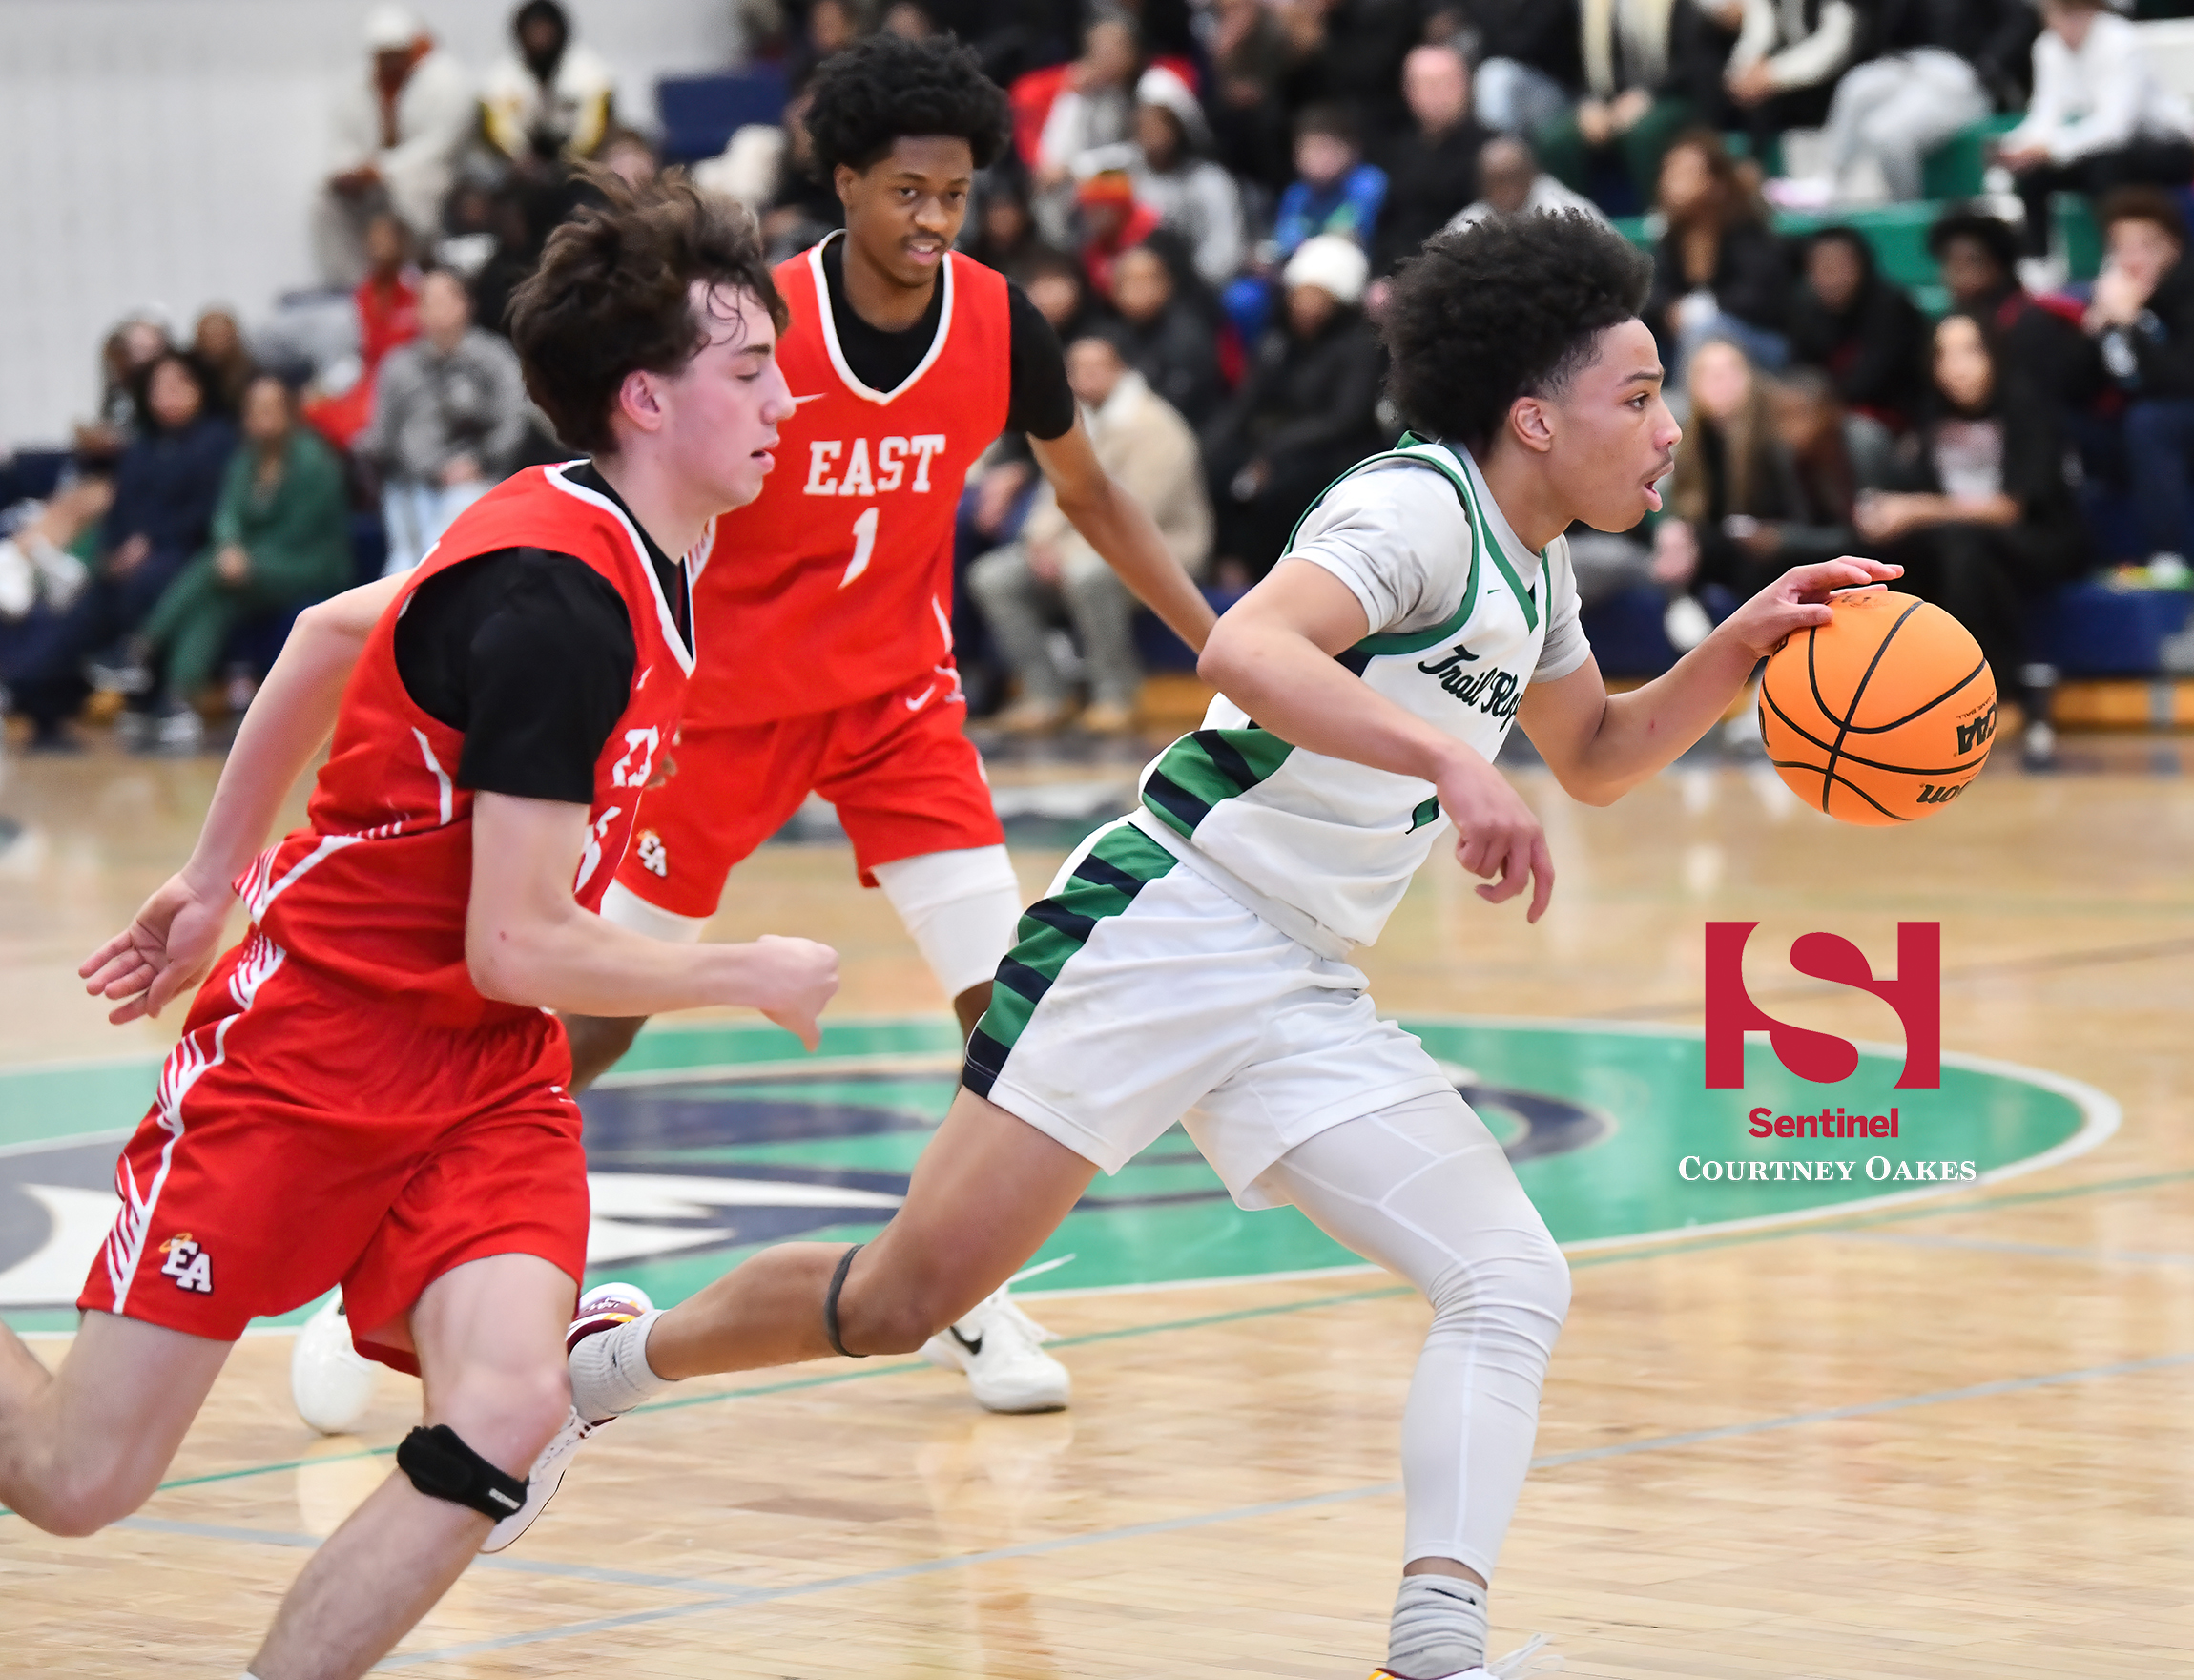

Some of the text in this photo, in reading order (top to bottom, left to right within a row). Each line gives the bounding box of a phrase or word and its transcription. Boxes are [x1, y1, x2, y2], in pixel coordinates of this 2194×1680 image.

[803, 434, 946, 497] EAST
[838, 507, 879, 591] 1
[1418, 644, 1498, 707] Trail
[160, 1237, 214, 1296] EA
